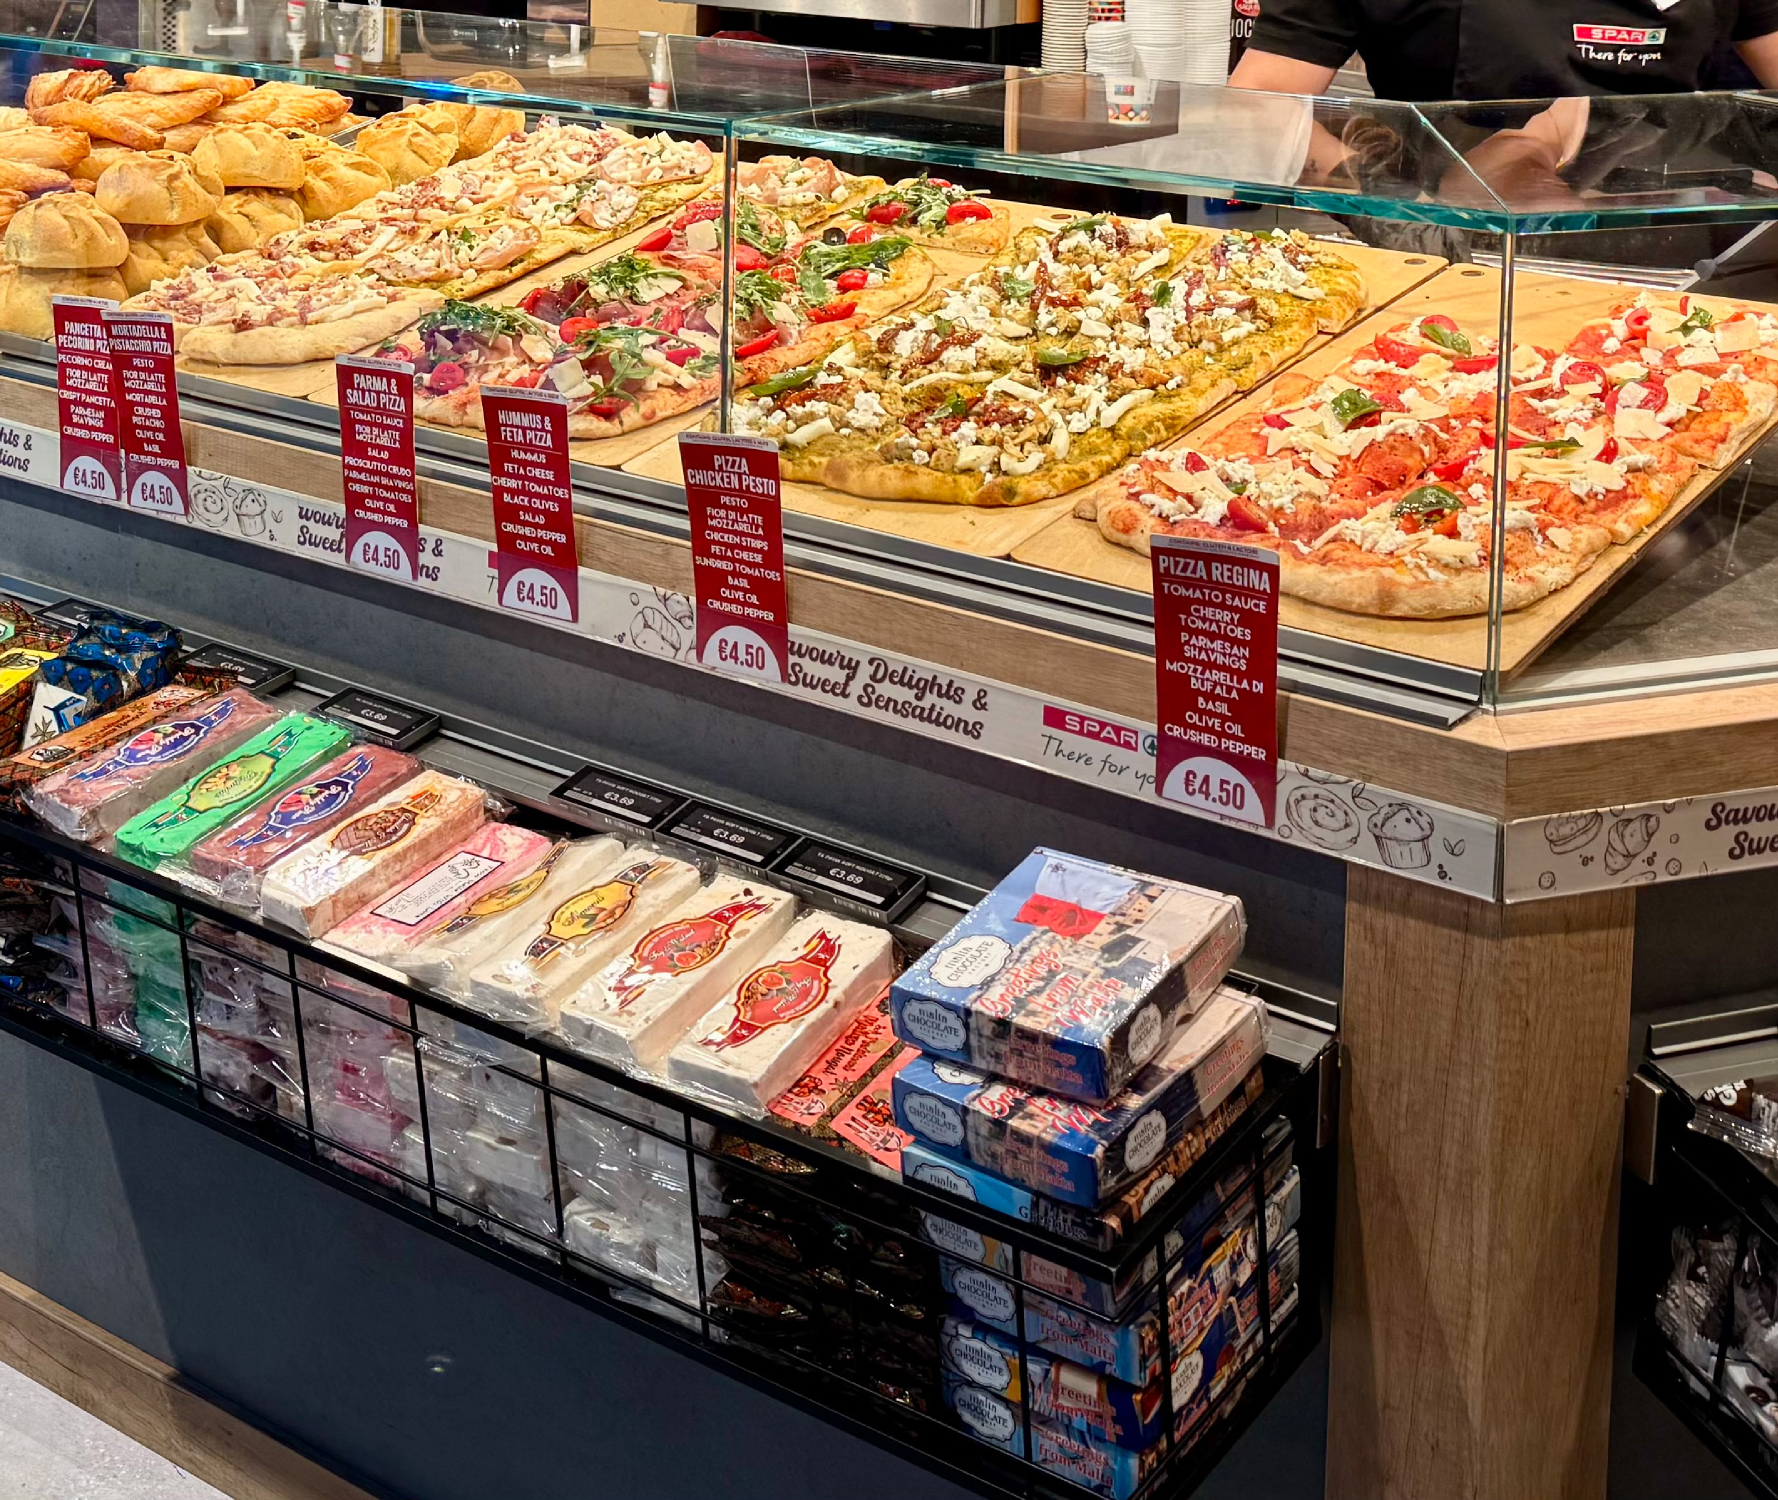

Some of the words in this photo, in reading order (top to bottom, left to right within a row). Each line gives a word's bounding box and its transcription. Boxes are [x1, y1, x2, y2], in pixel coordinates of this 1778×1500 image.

[1591, 28, 1643, 41] SPAR
[1576, 44, 1614, 61] There
[1617, 48, 1637, 65] for
[1638, 51, 1662, 66] you
[353, 373, 388, 393] PARMA
[390, 379, 398, 395] &
[346, 388, 377, 408] SALAD
[379, 393, 406, 413] PIZZA
[349, 410, 381, 423] TOMATO
[382, 415, 404, 428] SAUCE
[497, 409, 542, 429] HUMMUS
[544, 416, 552, 431] &
[23, 434, 33, 450] &
[500, 427, 525, 443] FETA
[526, 431, 553, 448] PIZZA
[510, 448, 546, 463] HUMMUS
[713, 455, 750, 474] PIZZA
[73, 466, 105, 491] €4.50
[503, 463, 525, 474] FETA
[526, 466, 555, 481] CHEESE
[687, 469, 740, 490] CHICKEN
[742, 477, 776, 496] PESTO
[141, 482, 173, 506] €4.50
[492, 475, 523, 490] CHERRY
[524, 481, 569, 499] TOMATOES
[503, 492, 530, 506] BLACK
[531, 498, 559, 512] OLIVES
[720, 496, 749, 508] PESTO
[519, 511, 546, 524] SALAD
[706, 506, 728, 520] FIOR
[728, 510, 736, 520] DI
[737, 512, 764, 525] LATTE
[707, 517, 764, 536] MOZZARELLA
[297, 524, 345, 554] Sweet
[501, 522, 536, 538] CRUSHED
[536, 527, 567, 543] PEPPER
[704, 530, 741, 544] CHICKEN
[741, 536, 769, 550] STRIPS
[362, 542, 401, 571] €4.50
[516, 539, 540, 553] OLIVE
[541, 545, 555, 556] OIL
[710, 545, 733, 558] FETA
[733, 549, 763, 563] CHEESE
[695, 555, 734, 571] SUNDRIED
[735, 563, 781, 582] TOMATOES
[1158, 554, 1208, 581] PIZZA
[1211, 562, 1271, 594] REGINA
[727, 575, 750, 589] BASIL
[516, 580, 558, 610] €4.50
[720, 587, 745, 601] OLIVE
[745, 593, 760, 605] OIL
[1162, 582, 1222, 603] TOMATO
[1225, 593, 1267, 614] SAUCE
[707, 598, 744, 616] CRUSHED
[744, 606, 775, 621] PEPPER
[1190, 605, 1240, 625] CHERRY
[1178, 614, 1252, 641] TOMATOES
[718, 638, 766, 671] €4.50
[1180, 632, 1250, 658] PARMESAN
[1184, 645, 1248, 671] SHAVINGS
[867, 656, 965, 707] Delights
[971, 688, 990, 712] &
[1165, 659, 1250, 691] MOZZARELLA
[1252, 680, 1264, 694] DI
[1190, 676, 1239, 700] BUFALA
[788, 661, 851, 699] Sweet
[856, 683, 985, 740] Sensations
[1197, 696, 1232, 716] BASIL
[1064, 714, 1138, 748] SPAR
[1185, 712, 1222, 731] OLIVE
[1224, 722, 1245, 738] OIL
[1164, 722, 1219, 748] CRUSHED
[1220, 738, 1266, 762] PEPPER
[1041, 733, 1094, 767] There
[1096, 754, 1130, 778] for
[1134, 767, 1157, 792] yo
[603, 791, 635, 806] €3.69
[1184, 769, 1245, 810] €4.50
[712, 827, 746, 844] €3.69
[828, 866, 865, 885] €3.69
[947, 941, 994, 982] CHOCOLATE
[978, 948, 1063, 1018] Greetings
[907, 1013, 960, 1038] CHOCOLATE
[907, 1107, 960, 1134] CHOCOLATE
[1127, 1122, 1163, 1157] CHOCOLATE
[958, 1279, 1009, 1309] CHOCOLATE
[1040, 1325, 1075, 1348] from
[1077, 1337, 1116, 1363] Malta
[954, 1349, 1005, 1377] CHOCOLATE
[958, 1397, 1009, 1429] CHOCOLATE
